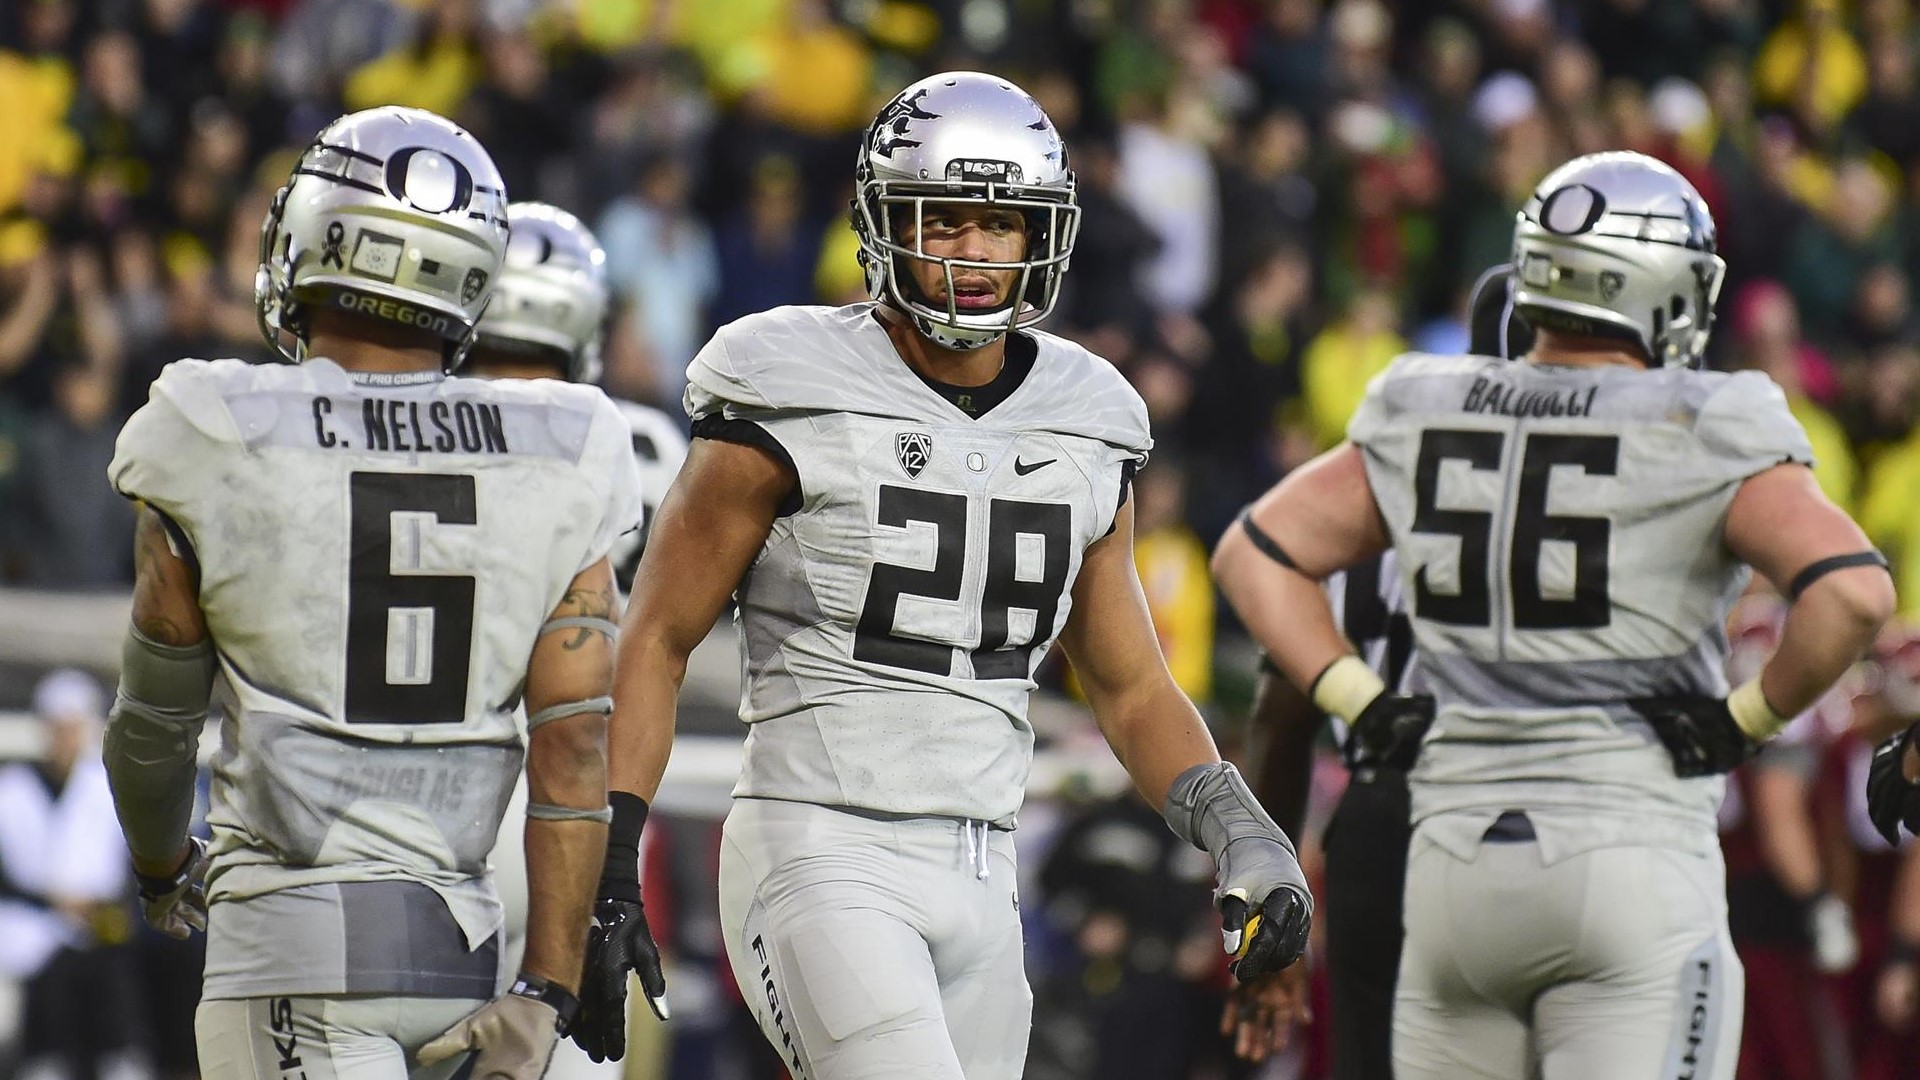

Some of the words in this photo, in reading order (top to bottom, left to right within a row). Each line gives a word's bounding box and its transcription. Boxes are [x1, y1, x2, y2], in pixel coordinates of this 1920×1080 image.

[385, 147, 473, 214] O
[369, 373, 393, 385] PRO
[312, 396, 349, 449] C.
[362, 398, 508, 453] NELSON
[900, 433, 931, 460] PAC
[905, 451, 923, 469] 12
[1411, 429, 1619, 628] 56
[345, 471, 477, 723] 6
[853, 484, 1073, 681] 28
[751, 933, 807, 1080] FIGHT
